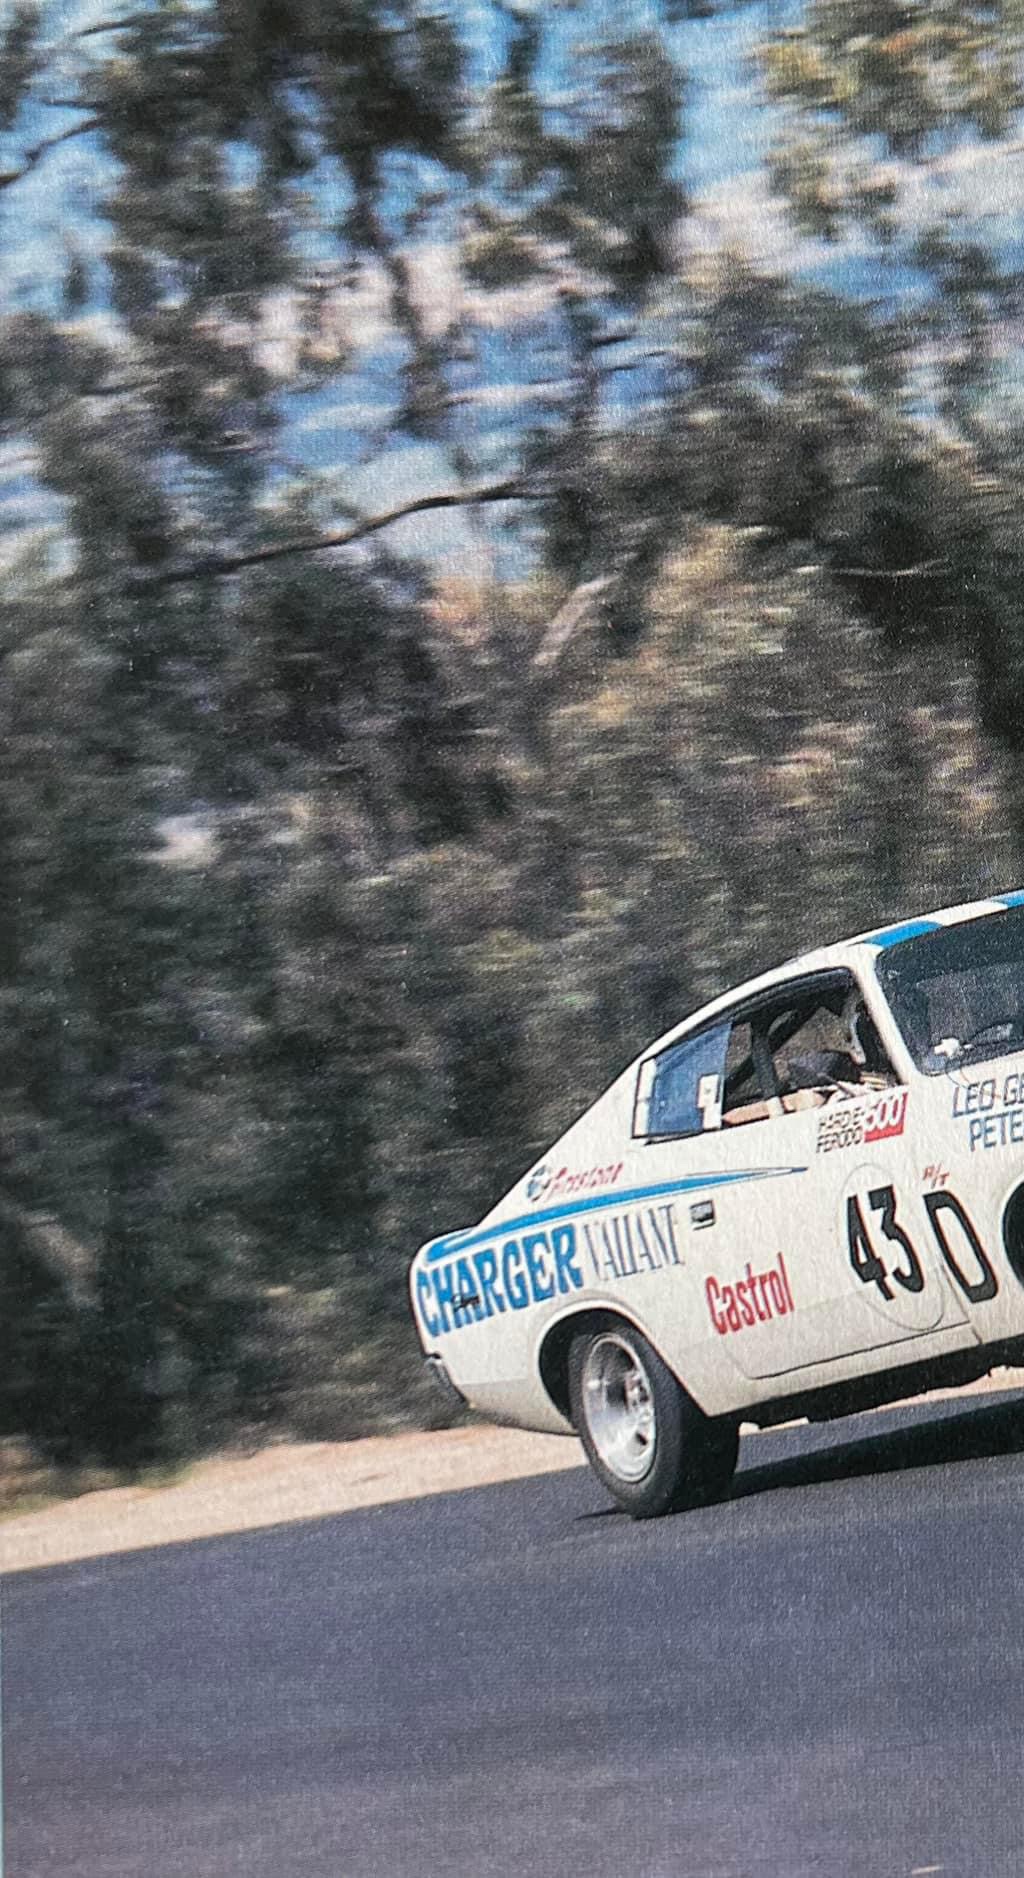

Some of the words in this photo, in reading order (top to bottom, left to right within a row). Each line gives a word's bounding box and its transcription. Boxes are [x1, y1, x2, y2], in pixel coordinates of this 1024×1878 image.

[864, 1095, 903, 1131] 500
[952, 1078, 996, 1118] LEO
[415, 1222, 584, 1339] CHARGER
[582, 1203, 686, 1282] VALIANT
[846, 1184, 925, 1302] 43
[705, 1251, 795, 1335] Castrol
